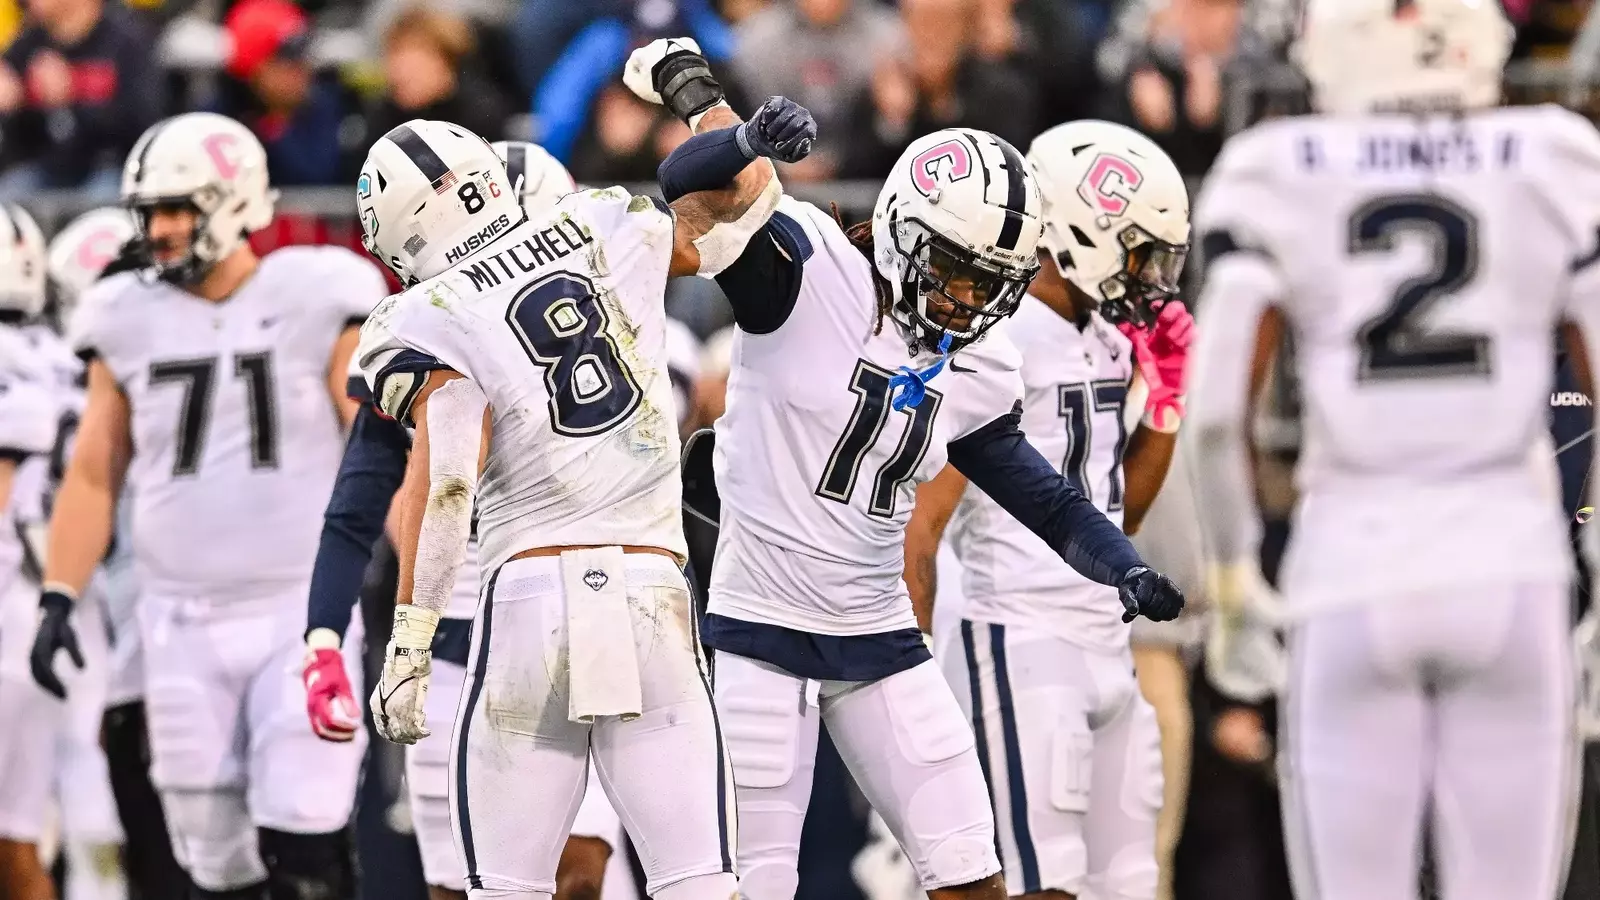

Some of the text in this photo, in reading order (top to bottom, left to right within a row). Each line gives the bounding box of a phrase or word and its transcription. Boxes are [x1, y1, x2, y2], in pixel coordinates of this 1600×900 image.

[457, 181, 485, 215] 8
[910, 139, 972, 198] C
[1076, 152, 1143, 216] C
[445, 214, 510, 263] HUSKIES
[460, 218, 593, 293] MITCHELL
[1348, 192, 1492, 383] 2
[505, 269, 643, 437] 8
[148, 348, 282, 477] 71
[815, 357, 943, 519] 11
[1057, 379, 1130, 512] 17
